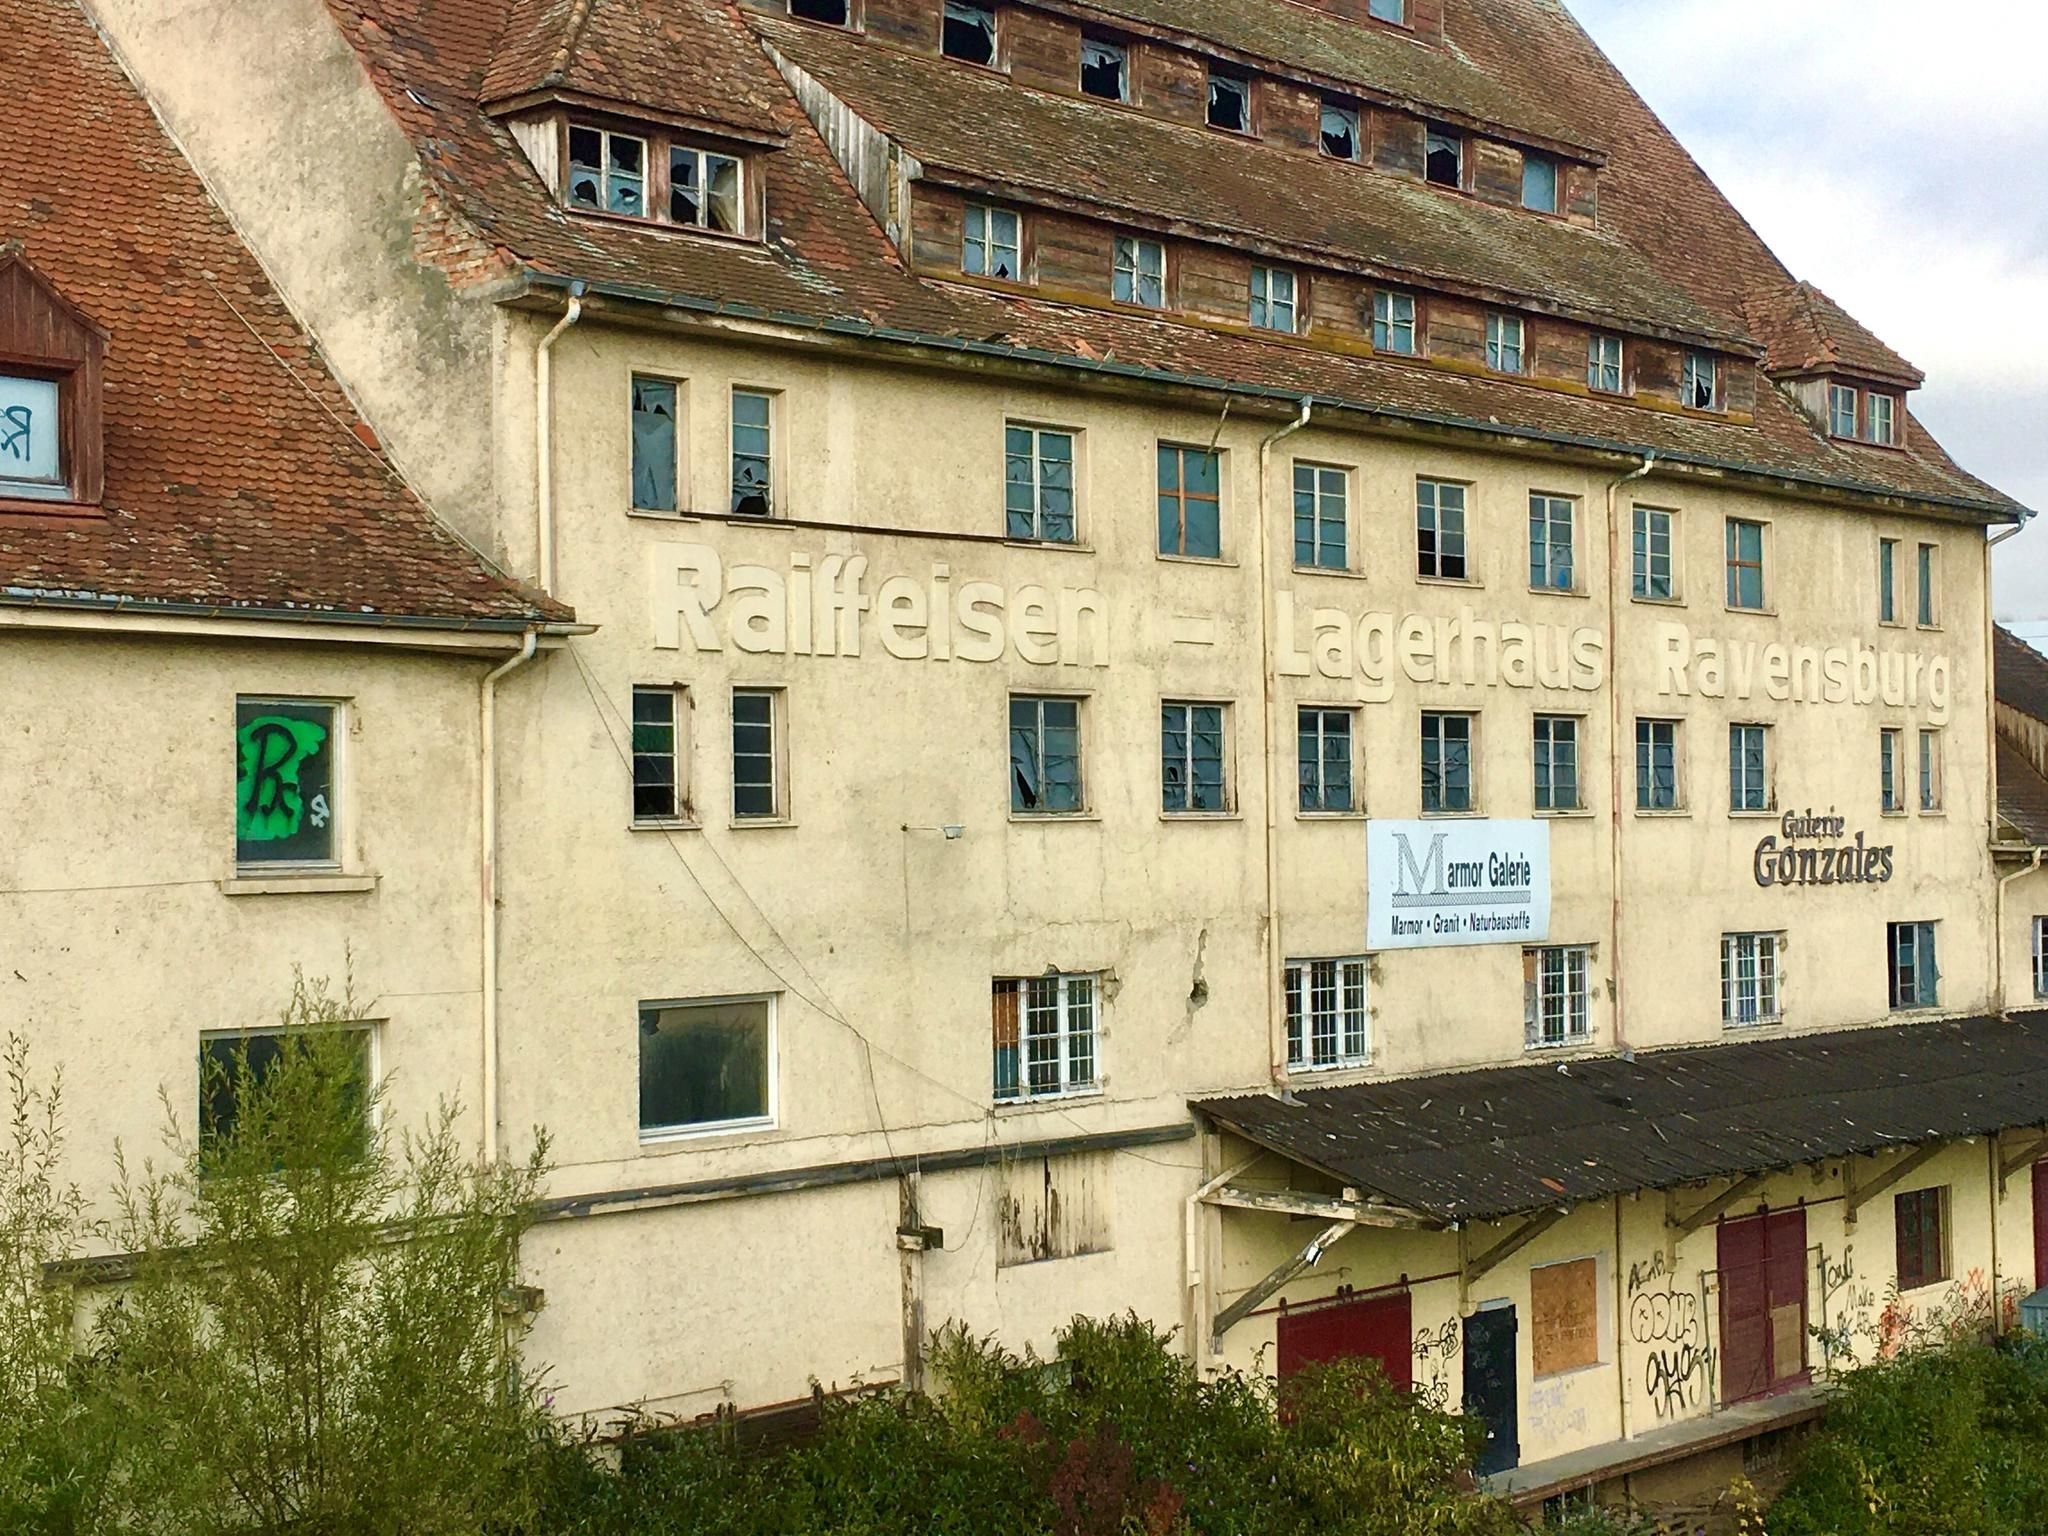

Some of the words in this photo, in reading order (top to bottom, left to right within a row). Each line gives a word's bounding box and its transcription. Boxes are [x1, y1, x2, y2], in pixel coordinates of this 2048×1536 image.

[652, 541, 1109, 667] Raiffeisen
[1277, 589, 1603, 702] Lagerhaus
[1656, 620, 1949, 726] Ravensburg
[1782, 805, 1844, 841] Galerie
[1488, 850, 1531, 888] Galerie
[1754, 831, 1893, 887] Gonzales
[1392, 915, 1423, 935] Marmor
[1433, 913, 1460, 934] Granit
[1470, 911, 1530, 932] Naturbaustoffe
